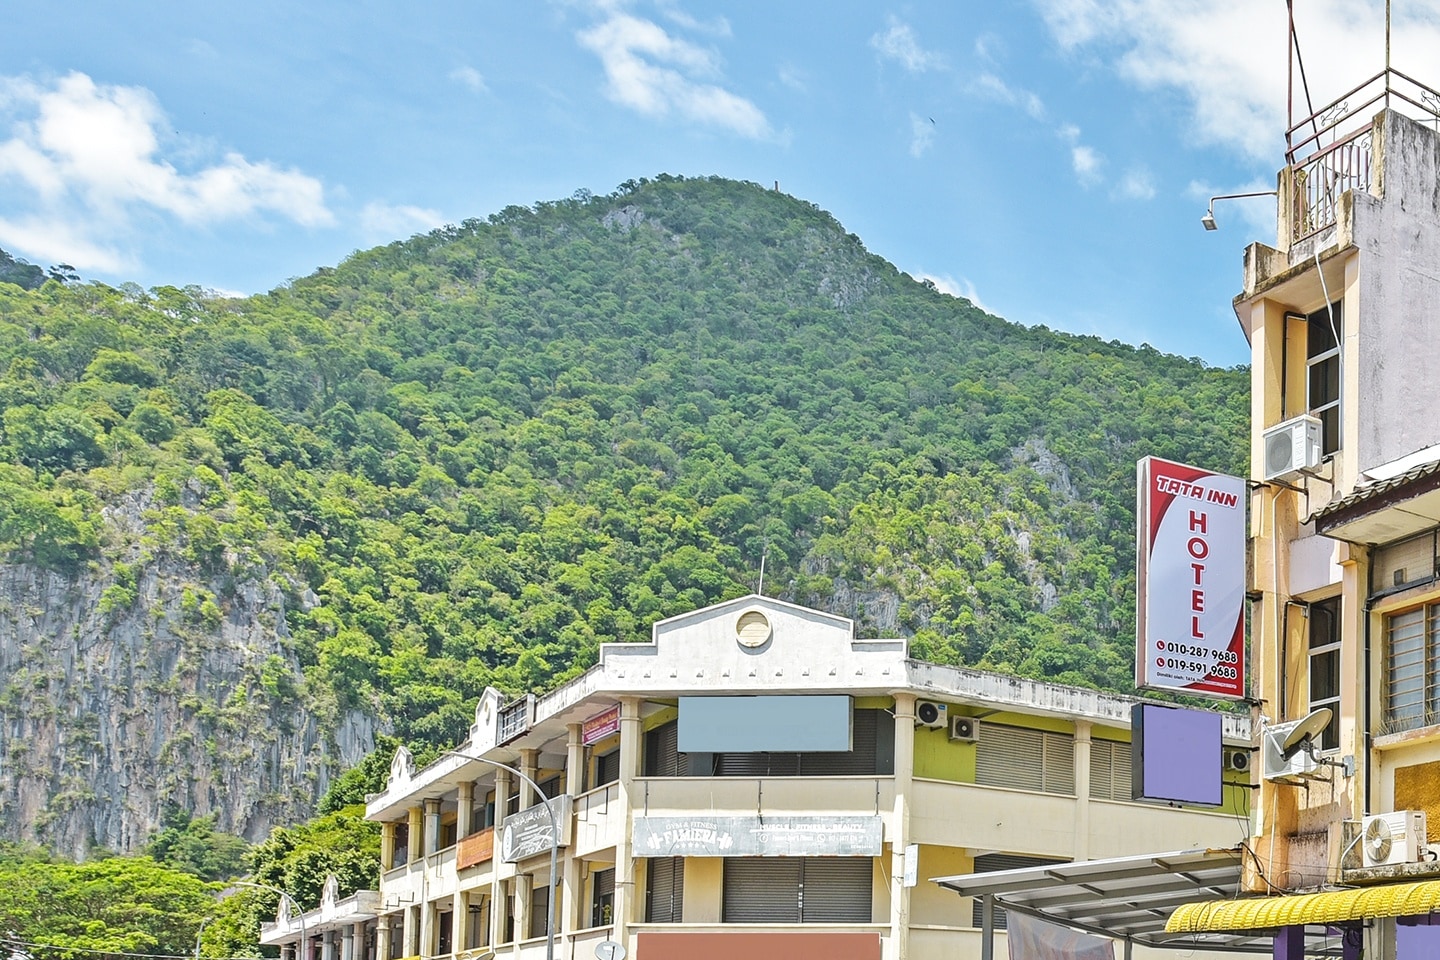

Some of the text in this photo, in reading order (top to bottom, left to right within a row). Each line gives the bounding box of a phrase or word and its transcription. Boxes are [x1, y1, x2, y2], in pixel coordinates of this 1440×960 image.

[1157, 476, 1238, 508] TATA INN
[1186, 510, 1209, 639] HOTEL
[1167, 642, 1237, 663] 010-287 9688
[1167, 658, 1236, 679] 019-591 9688
